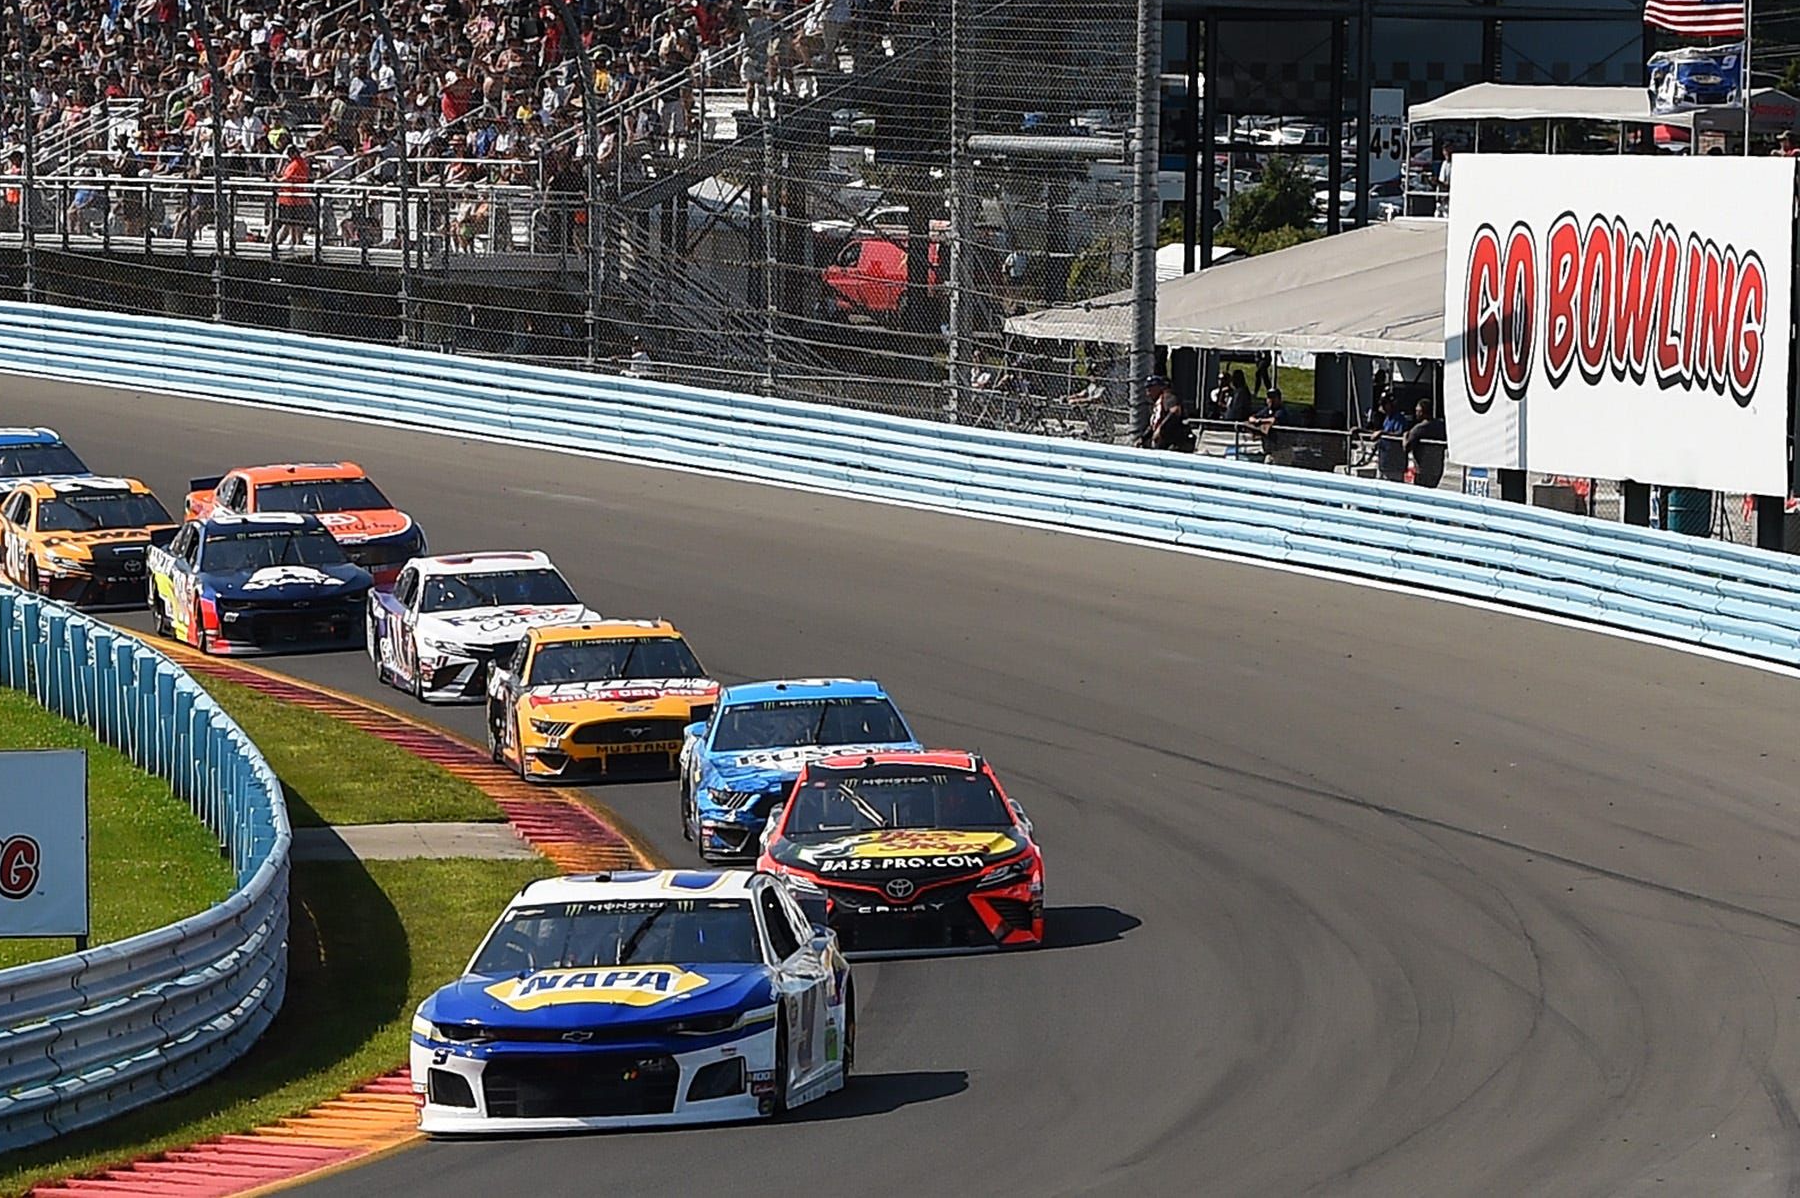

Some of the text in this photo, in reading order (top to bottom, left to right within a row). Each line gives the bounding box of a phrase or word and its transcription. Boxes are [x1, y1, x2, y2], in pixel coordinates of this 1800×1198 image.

[1462, 210, 1768, 414] GO BOWLING
[595, 741, 678, 754] MUSTANG
[519, 971, 671, 997] NAPA
